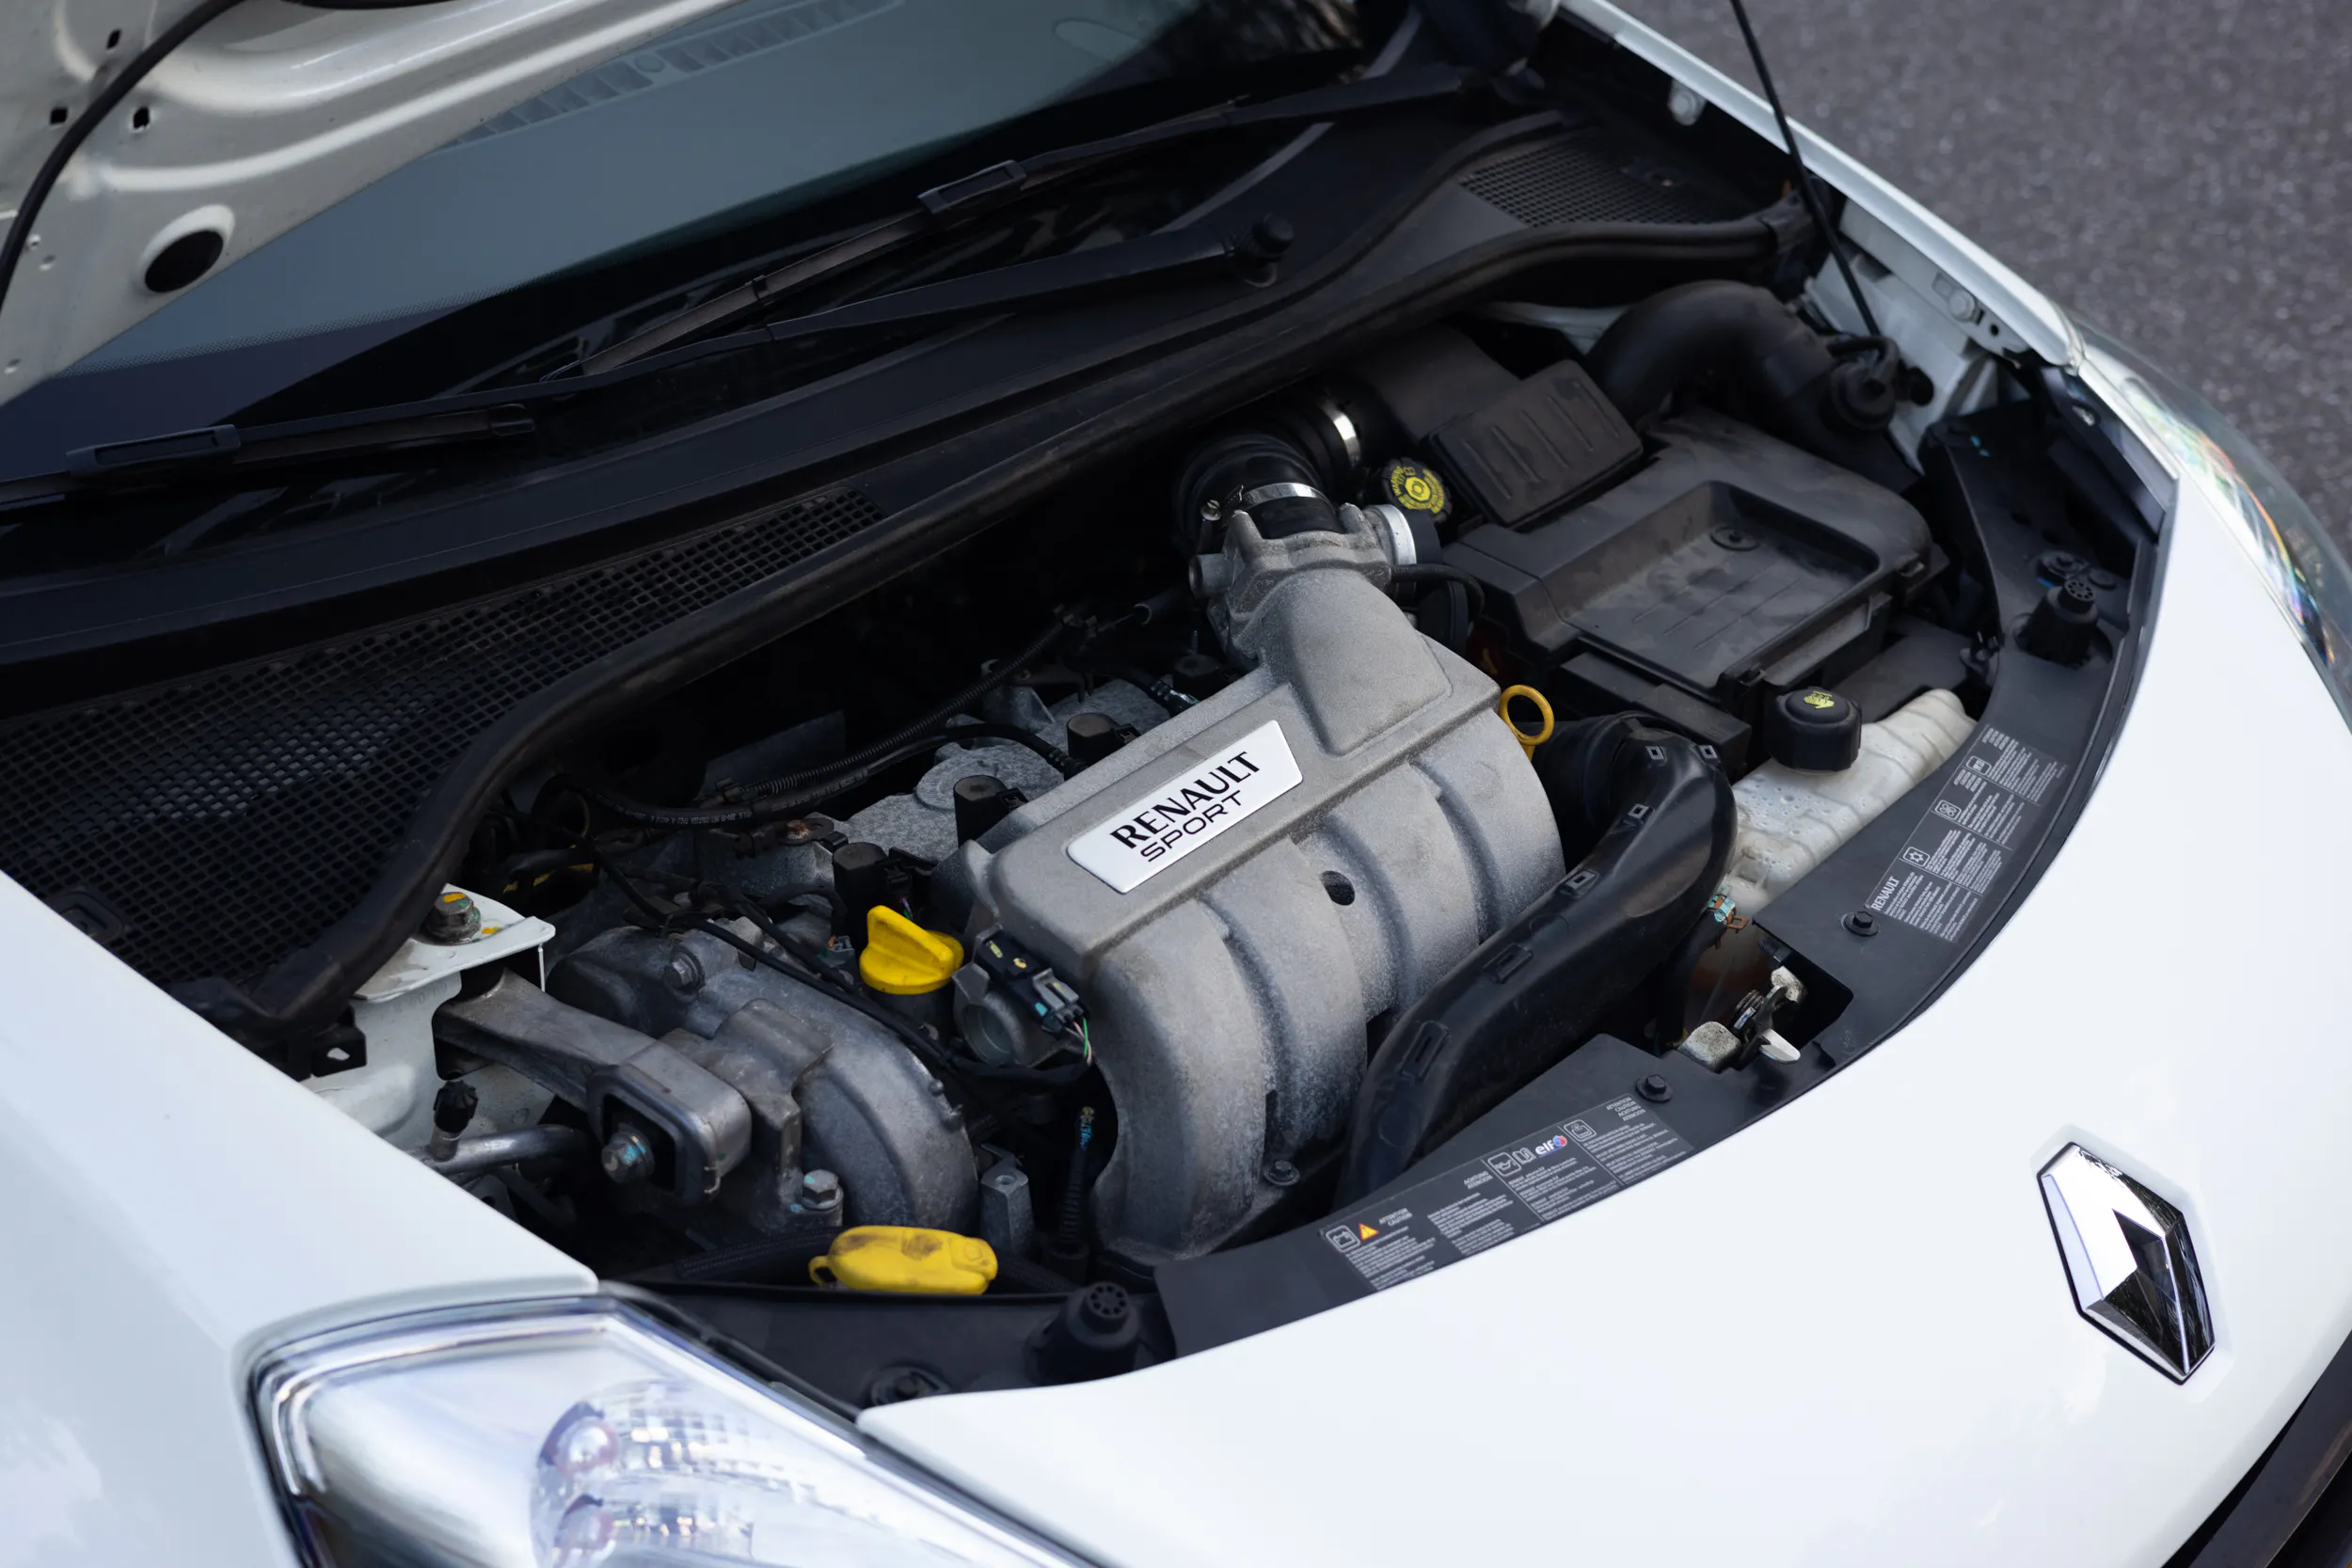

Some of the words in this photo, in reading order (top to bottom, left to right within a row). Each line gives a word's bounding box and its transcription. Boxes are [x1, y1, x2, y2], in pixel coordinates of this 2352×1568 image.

[1109, 751, 1260, 849] RENAULT
[1140, 790, 1242, 862] SPORT
[1870, 876, 1899, 911] RENAULT
[1606, 1097, 1632, 1111] ATTENTION
[1614, 1101, 1637, 1112] CAUTION
[1618, 1104, 1642, 1117] ACHTUNG
[1534, 1139, 1555, 1155] elf
